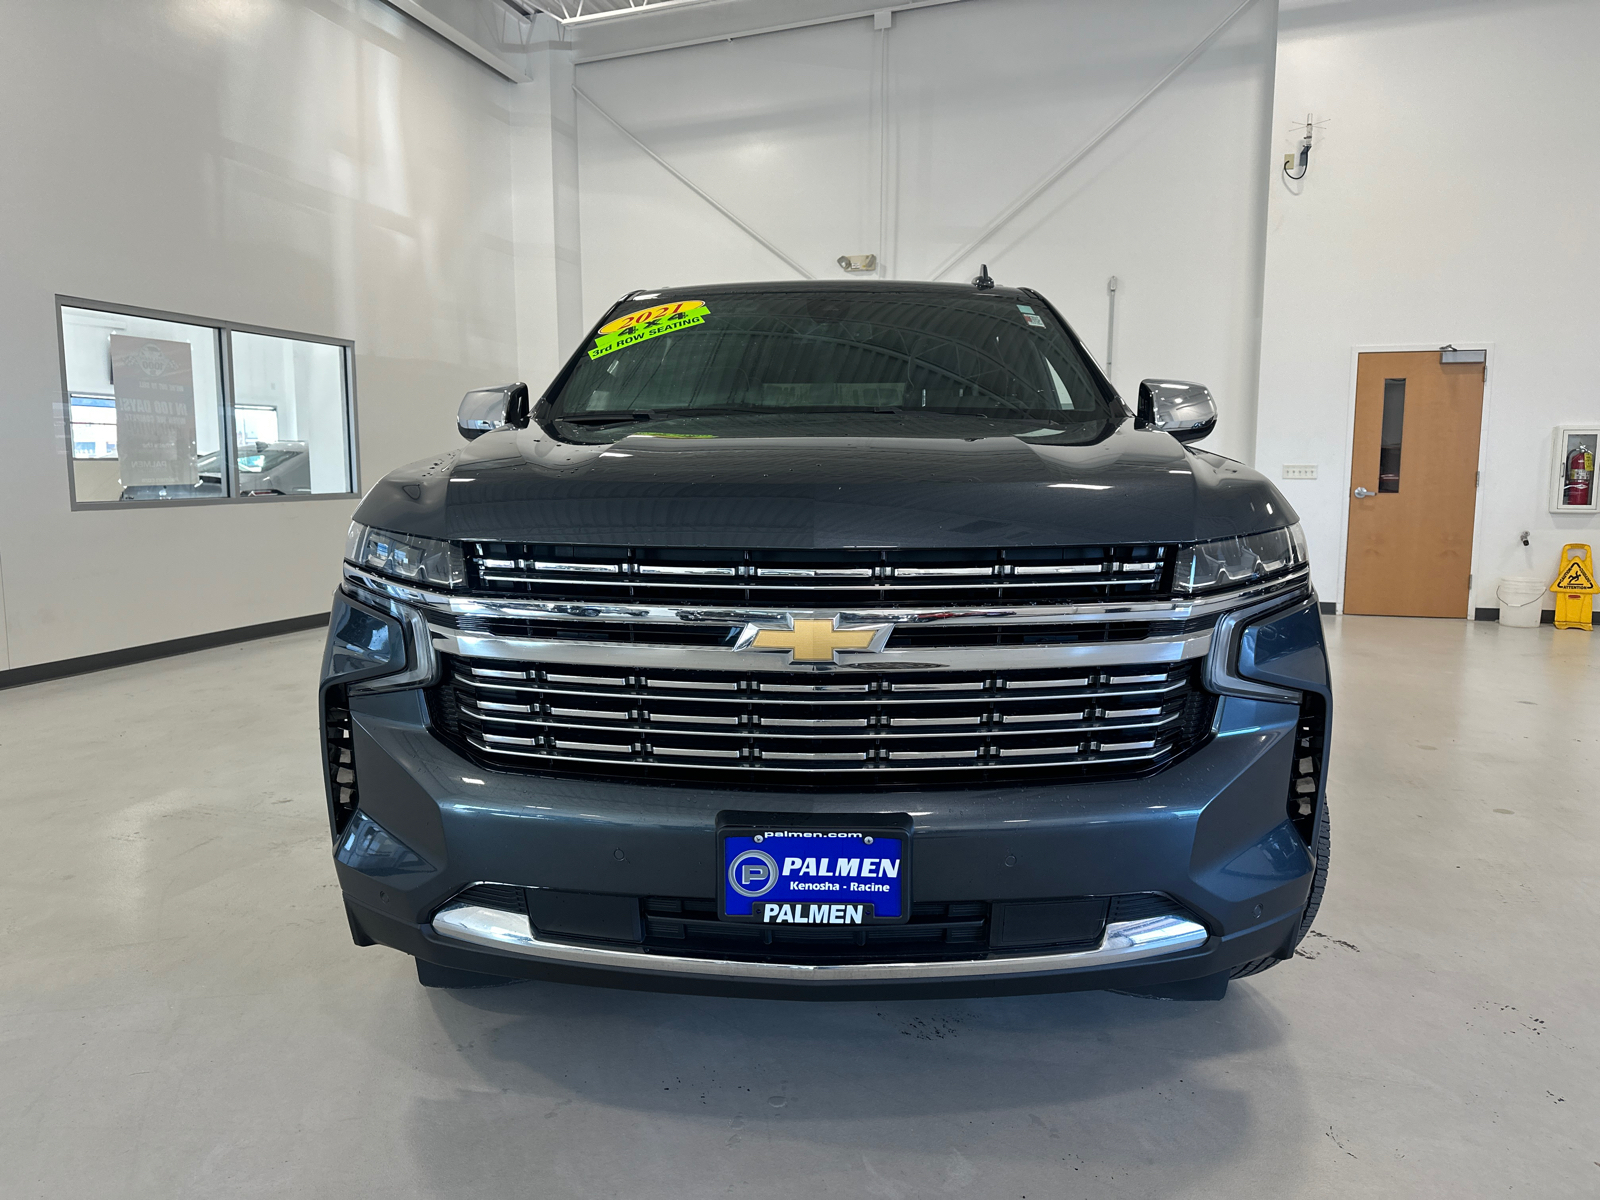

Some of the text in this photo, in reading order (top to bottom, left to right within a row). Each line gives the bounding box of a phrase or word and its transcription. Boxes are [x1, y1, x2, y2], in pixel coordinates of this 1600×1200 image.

[618, 303, 683, 330] 2021
[592, 317, 700, 357] 3rd ROW SEATING
[764, 830, 863, 838] palmen.com
[782, 857, 900, 878] PALMEN
[790, 881, 840, 891] Kenosha
[850, 882, 890, 892] Racine
[763, 904, 864, 924] PALMEN
